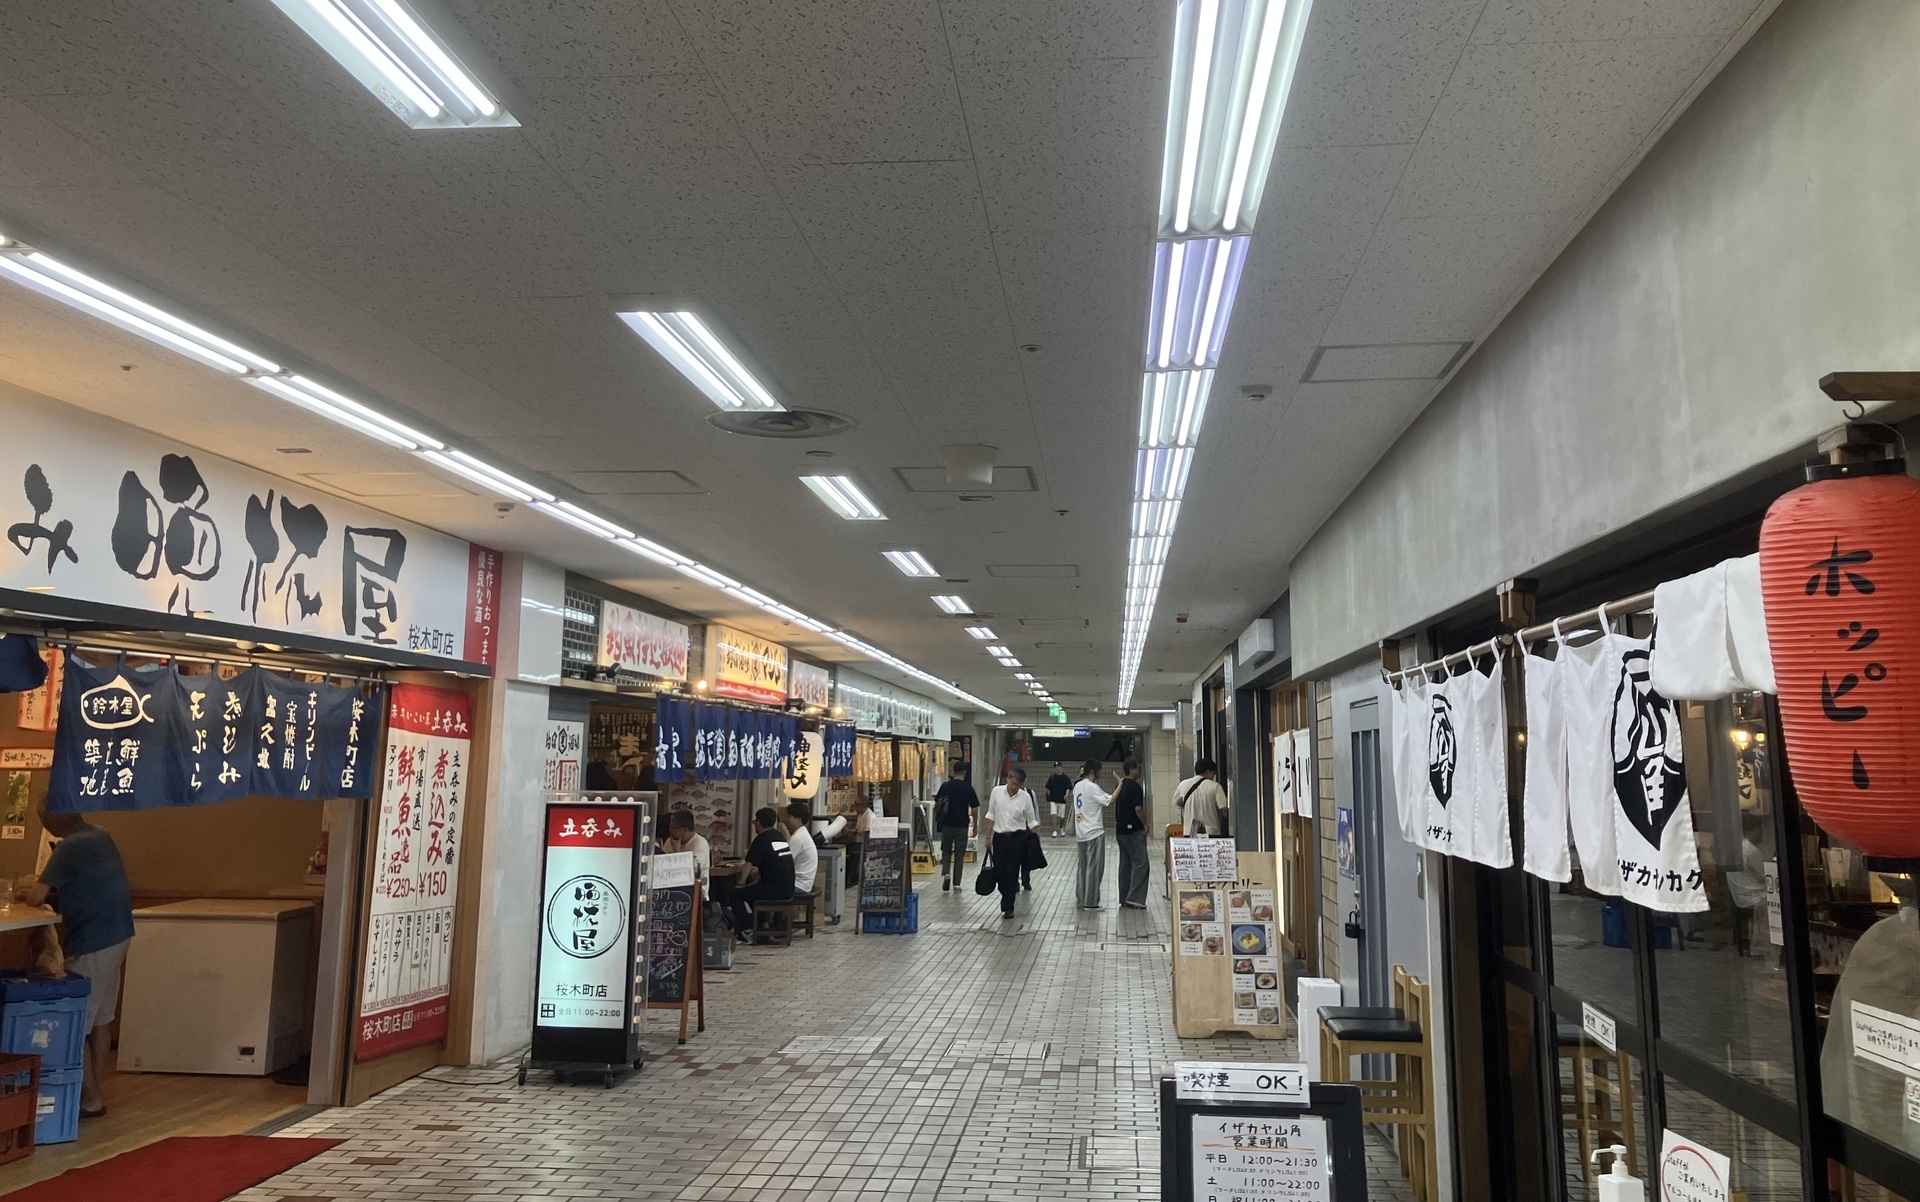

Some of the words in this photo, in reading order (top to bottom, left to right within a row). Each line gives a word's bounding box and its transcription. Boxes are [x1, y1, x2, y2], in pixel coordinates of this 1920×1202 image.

[475, 551, 486, 623] 優良な酒
[407, 623, 455, 656] 桜木町店
[1805, 536, 1887, 790] ホッピー
[92, 696, 133, 715] 鈴木屋
[283, 700, 298, 770] 宝焼酎
[299, 691, 317, 791] キリンビール
[341, 697, 364, 788] 桜木町店
[112, 738, 141, 796] 鮮魚
[412, 746, 425, 831] 市場直送
[1076, 793, 1082, 808] 6
[426, 748, 449, 867] 煮込み
[559, 817, 623, 838] 立呑み
[419, 870, 447, 899] ¥150
[434, 912, 441, 934] お酒
[556, 983, 608, 998] 桜木町店
[362, 1013, 401, 1041] 桜木町店
[1184, 1072, 1231, 1089] 喫煙
[1219, 1122, 1301, 1137] イザカヤ山角
[1232, 1136, 1288, 1148] 営業時間
[1205, 1153, 1227, 1163] 平日
[1207, 1176, 1217, 1185] 土
